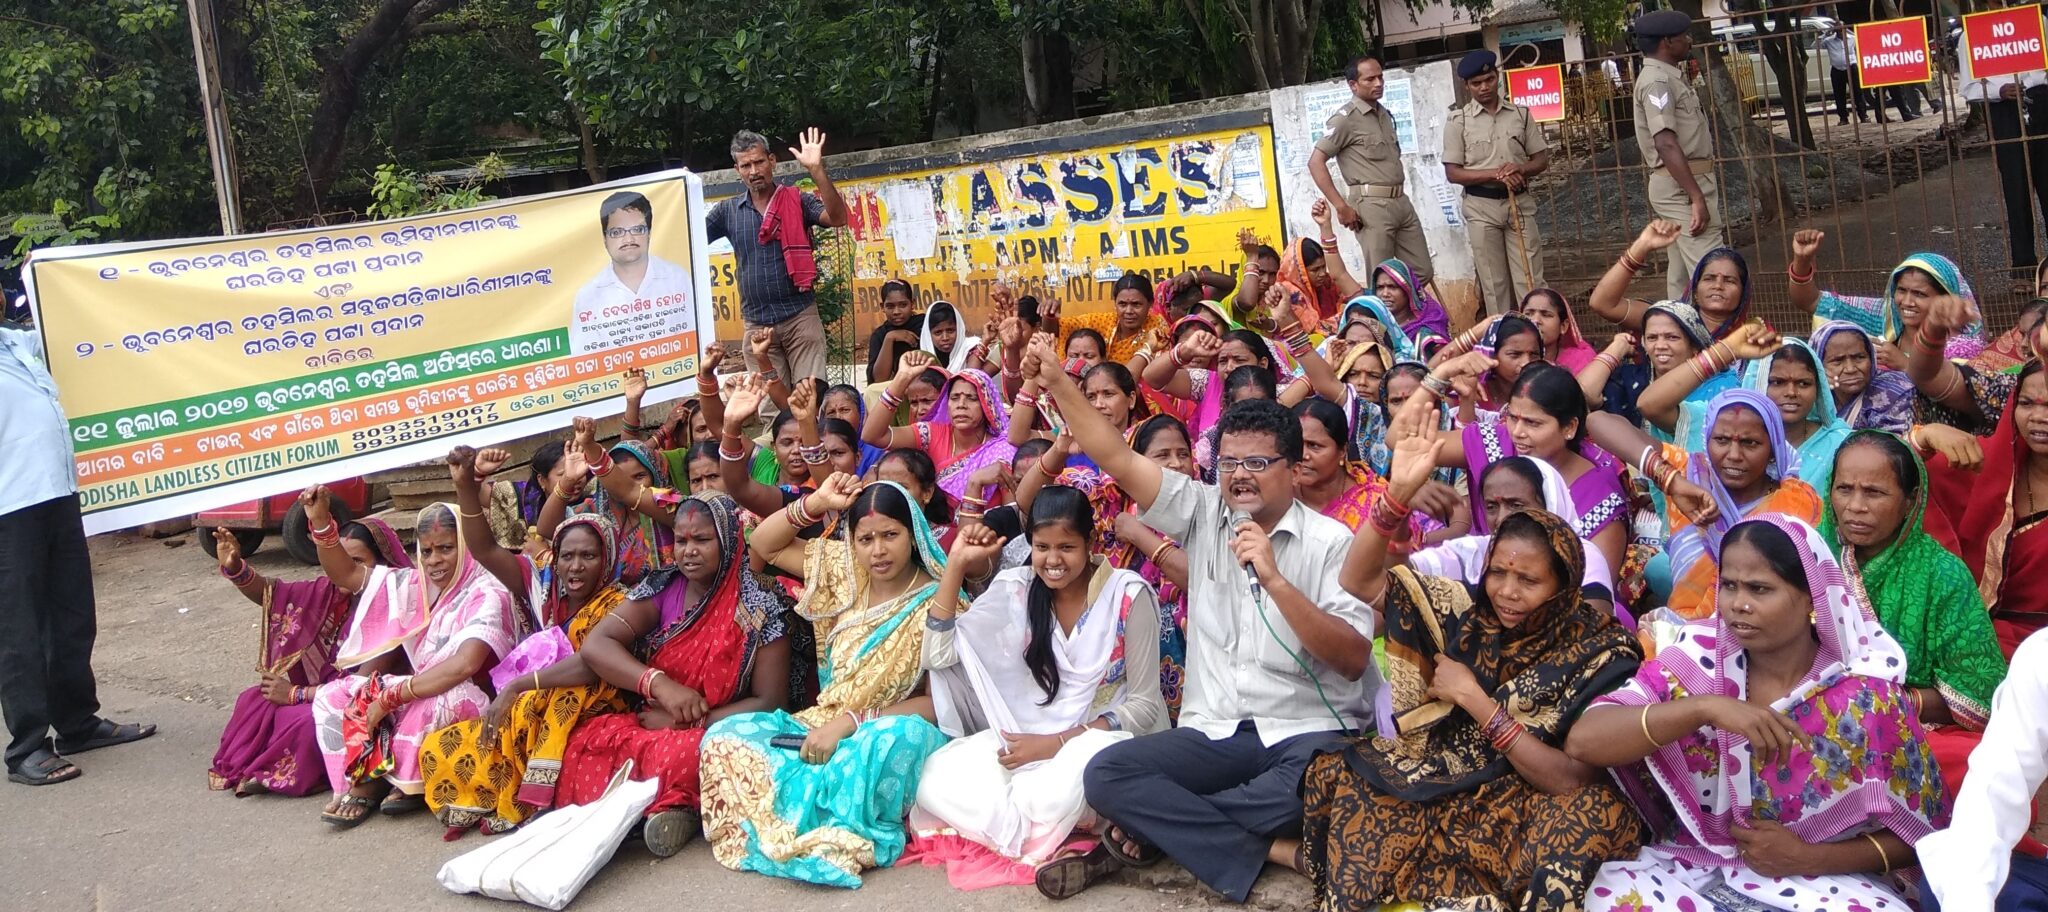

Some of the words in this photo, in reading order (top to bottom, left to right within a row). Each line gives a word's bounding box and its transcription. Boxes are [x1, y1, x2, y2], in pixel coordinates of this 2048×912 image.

[1880, 32, 1902, 48] NO
[1992, 21, 2015, 38] NO
[1862, 49, 1925, 69] PARKING
[1972, 38, 2041, 61] PARKING
[1527, 77, 1543, 90] NO
[1513, 92, 1560, 107] PARKING
[276, 235, 374, 259] ତହସିଲର
[996, 236, 1076, 267] AIPM
[1100, 225, 1190, 260] AIMS
[364, 250, 424, 272] ପ୍ରଦାନ
[313, 282, 353, 300] ଏବଂ
[241, 305, 333, 331] ତହସିଲର
[371, 313, 424, 336] ପ୍ରଦାନ
[304, 346, 374, 369] ଦାବିରେ
[662, 357, 694, 376] ସମିତି
[74, 421, 109, 442] ୧୧
[115, 408, 179, 439] ଜୁଲାଇ
[184, 395, 249, 423] ୨୦୧୭
[355, 360, 420, 389] ତହସିଲ
[77, 454, 125, 477] ଆମର
[131, 442, 165, 465] ଦାବି
[248, 423, 278, 442] ଏବଂ
[329, 407, 358, 427] ଥିବା
[603, 350, 635, 372] ପ୍ରଦାନ
[352, 402, 497, 441] 8093519067
[353, 413, 500, 452] 9938893415
[80, 480, 140, 508] ODISHA
[145, 463, 220, 494] LANDLESS
[225, 450, 282, 476] CITIZEN
[287, 438, 340, 464] FORUM
